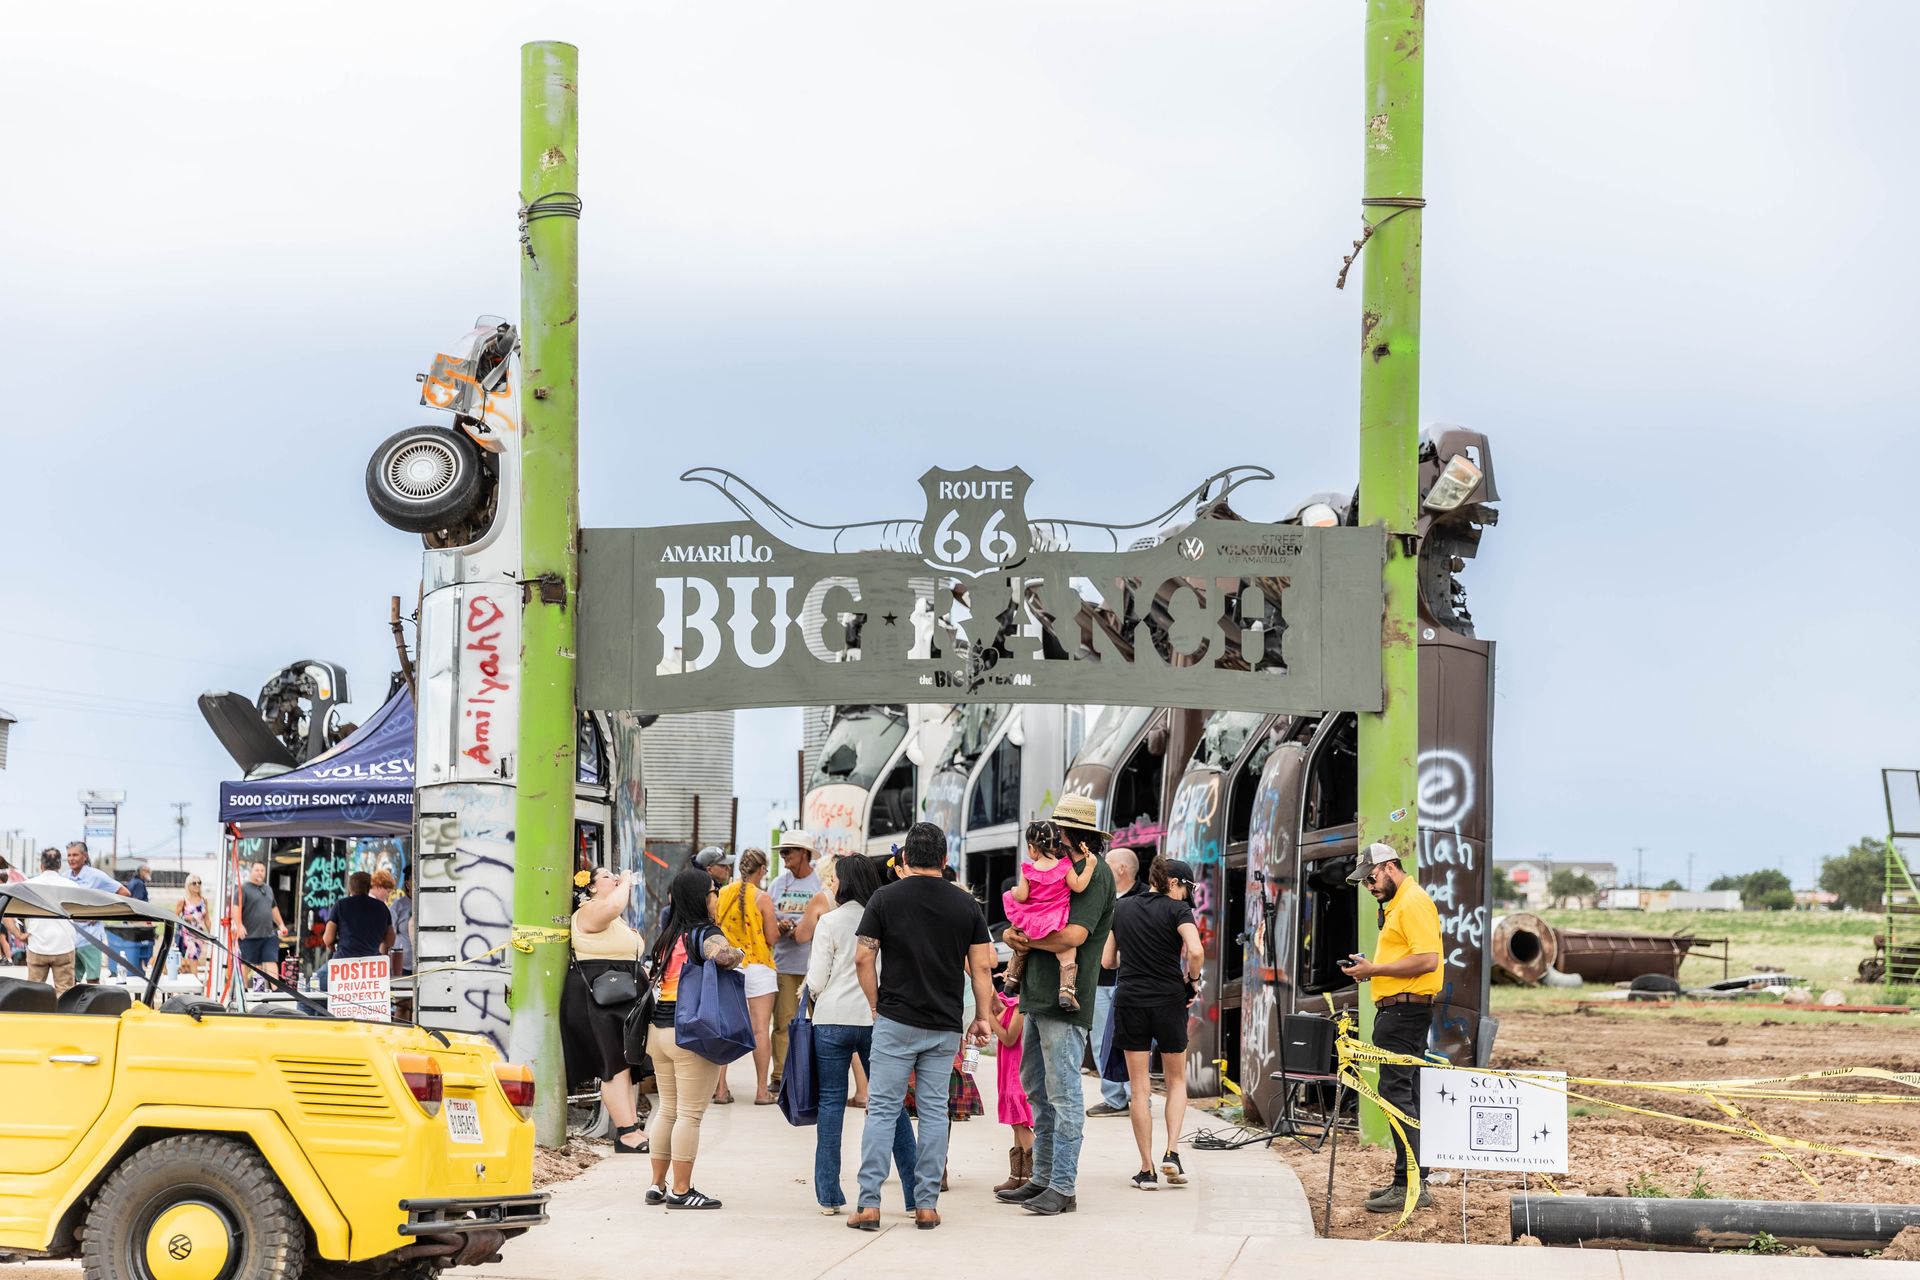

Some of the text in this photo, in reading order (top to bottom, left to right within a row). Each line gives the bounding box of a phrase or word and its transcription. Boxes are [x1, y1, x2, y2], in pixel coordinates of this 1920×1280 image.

[939, 481, 1014, 500] ROUTE
[933, 509, 1017, 563] 66
[1262, 535, 1304, 546] STREET
[1217, 545, 1303, 557] VOLKSWAGEN
[655, 576, 1291, 676] BUG RANCH
[919, 674, 933, 685] the
[934, 670, 964, 688] BIG
[229, 794, 262, 806] 5000
[264, 794, 309, 806] SOUTH
[312, 794, 355, 806] SONCY
[331, 961, 388, 981] POSTED
[338, 981, 380, 992] PRIVATE
[331, 991, 386, 1003] PROPERTY
[332, 1004, 387, 1016] TRESPASSING
[1470, 1077, 1518, 1089] SCAN
[1469, 1095, 1523, 1105] DONATE
[453, 1102, 469, 1111] TEXAS
[1437, 1153, 1556, 1165] BUG RANCH ASSOCIATION
